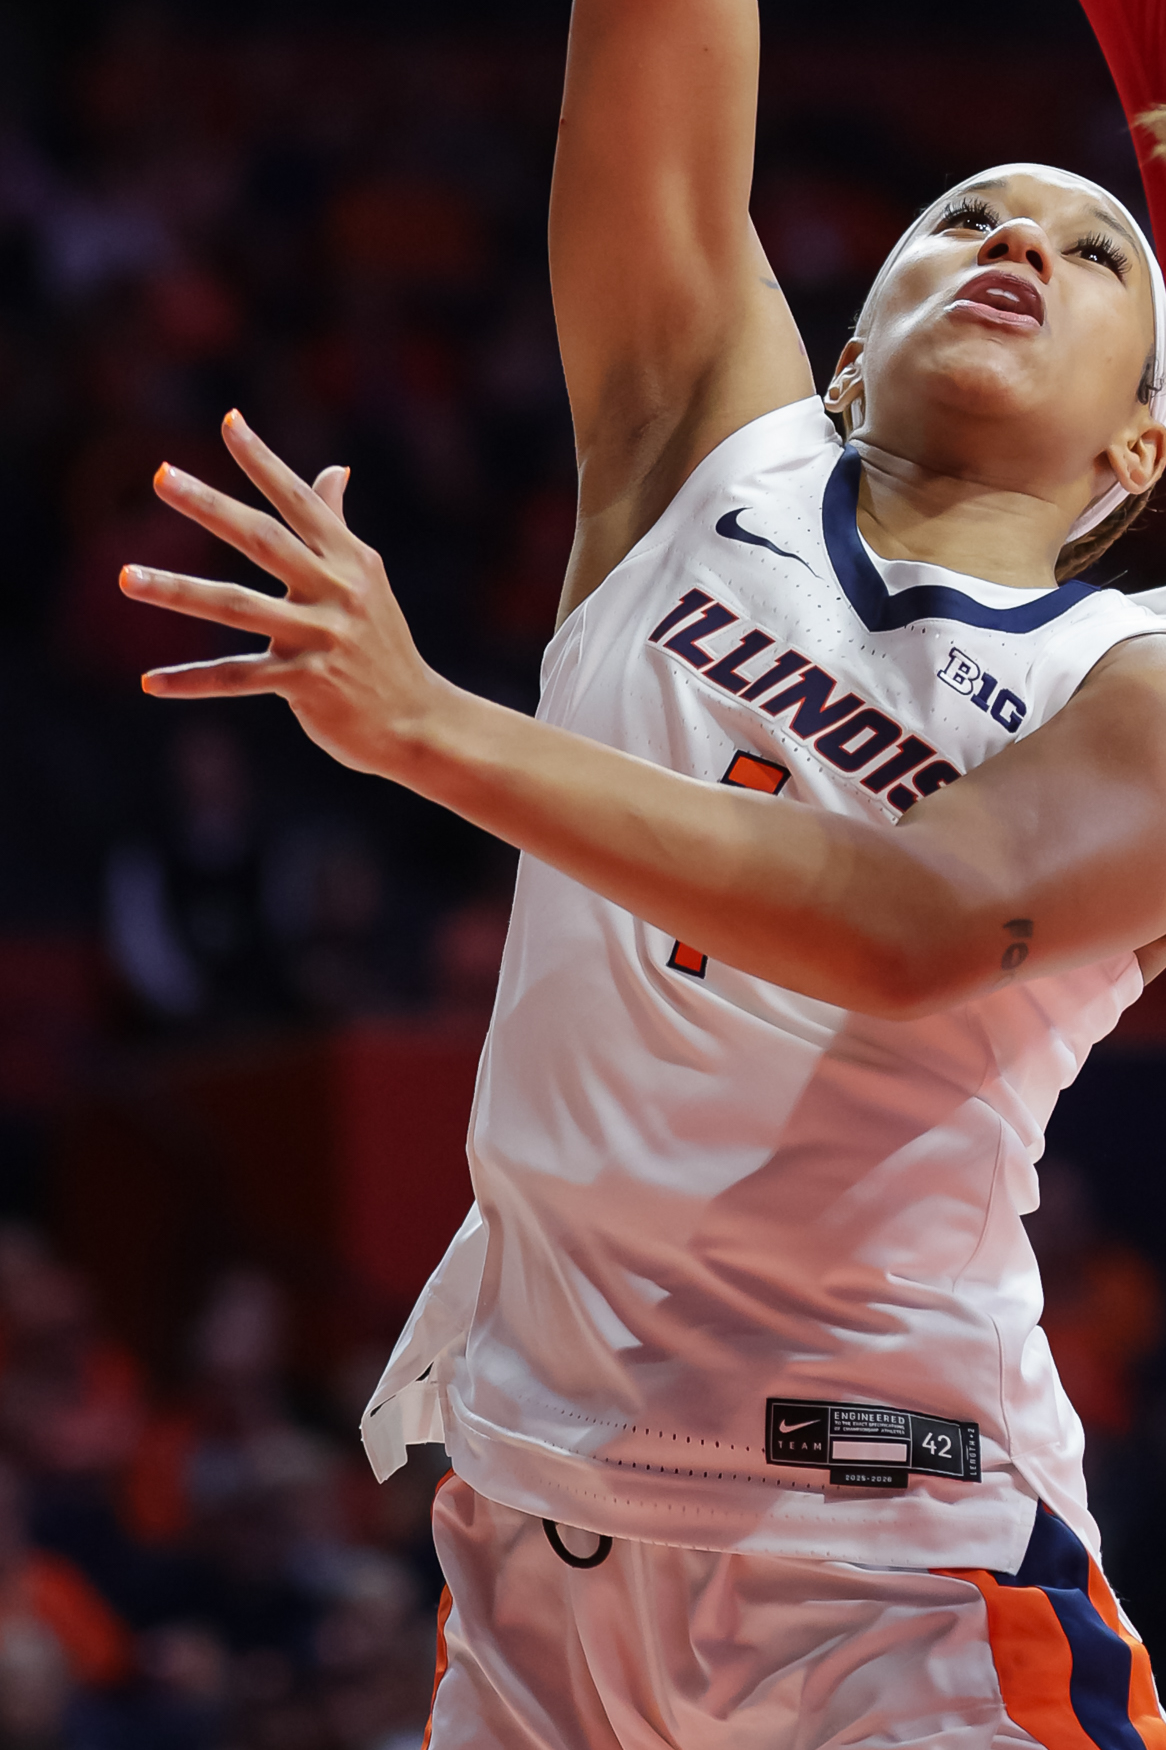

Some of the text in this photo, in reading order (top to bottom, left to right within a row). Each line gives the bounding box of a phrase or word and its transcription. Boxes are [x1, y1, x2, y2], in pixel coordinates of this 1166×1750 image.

[834, 1411, 906, 1425] ENGINEERED
[778, 1440, 822, 1451] TEAM
[921, 1432, 953, 1459] 42
[968, 1440, 978, 1476] LENGTH
[845, 1474, 893, 1482] 2025-2026
